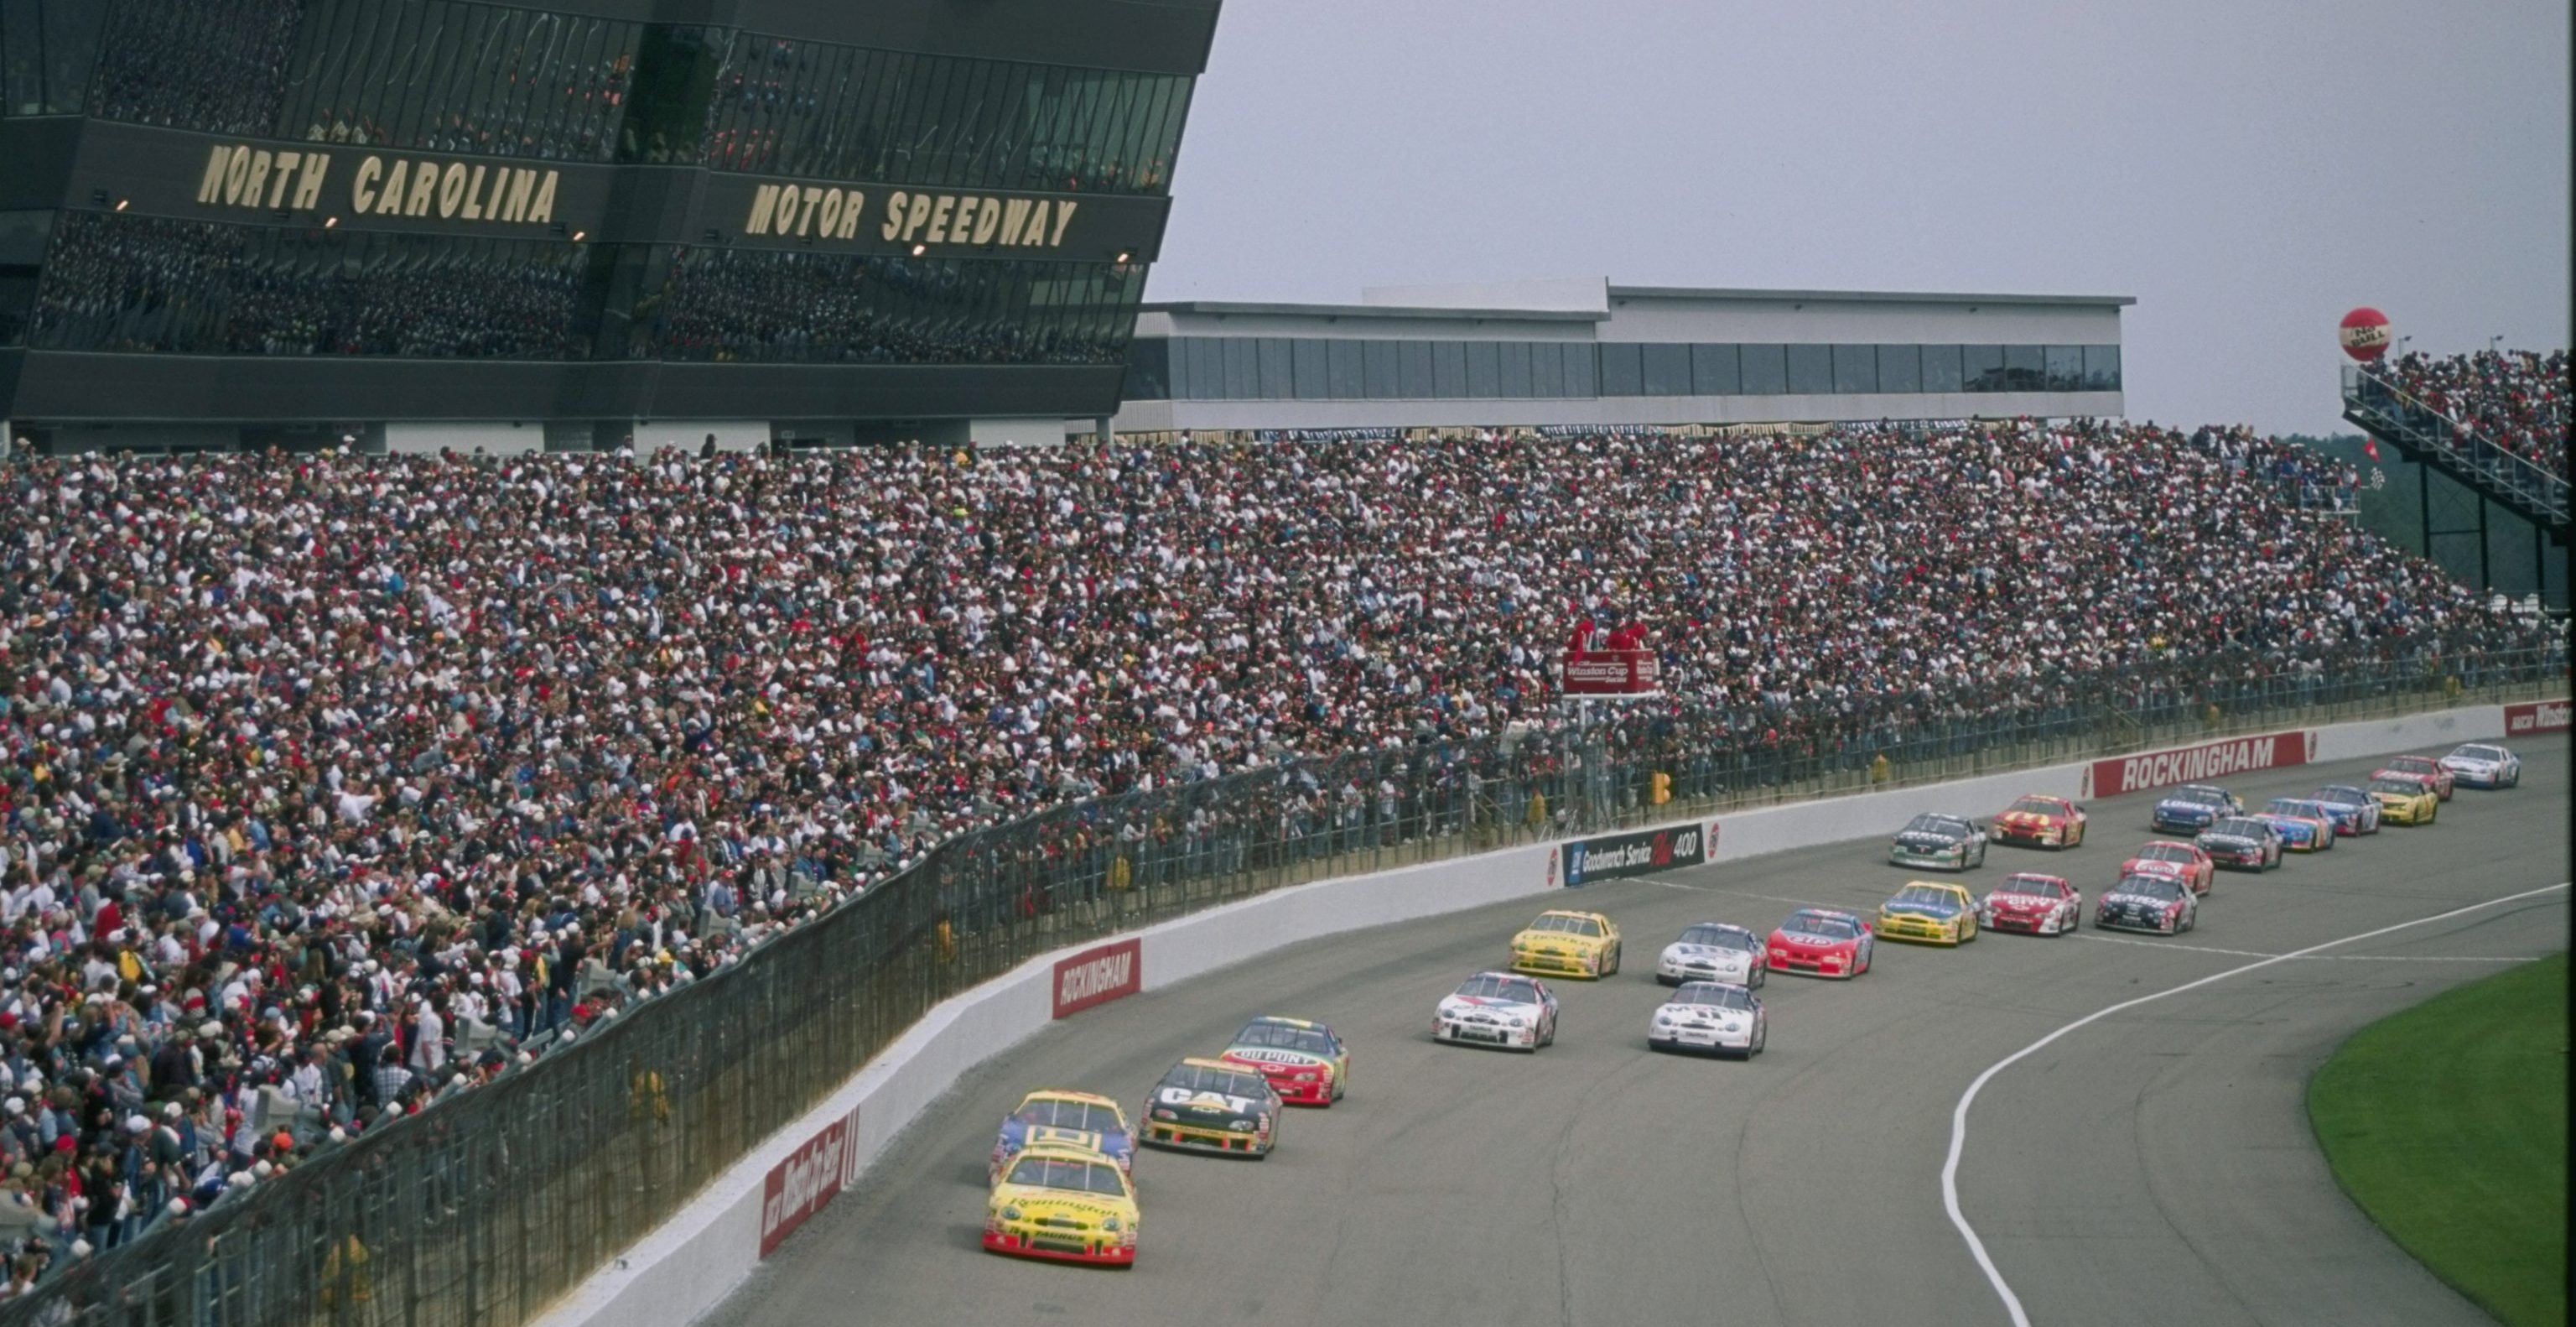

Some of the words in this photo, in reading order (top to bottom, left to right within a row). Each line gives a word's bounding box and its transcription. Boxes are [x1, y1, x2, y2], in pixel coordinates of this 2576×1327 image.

[197, 144, 330, 210] NORTH
[352, 155, 559, 224] CAROLINA
[745, 184, 865, 239] MOTOR
[881, 191, 1078, 247] SPEEDWAY
[1567, 667, 1607, 675] Winston
[1607, 666, 1628, 676] Cup
[2122, 737, 2275, 791] ROCKINGHAM
[1582, 844, 1625, 873] Goodwrench
[1625, 841, 1652, 866] Service
[1674, 830, 1697, 858] 400
[1060, 950, 1132, 1006] ROCKINGHAM
[1239, 1050, 1263, 1059] DU
[1265, 1052, 1309, 1064] PONT
[1161, 1088, 1256, 1113] CAT
[1035, 1230, 1086, 1241] TAURUS
